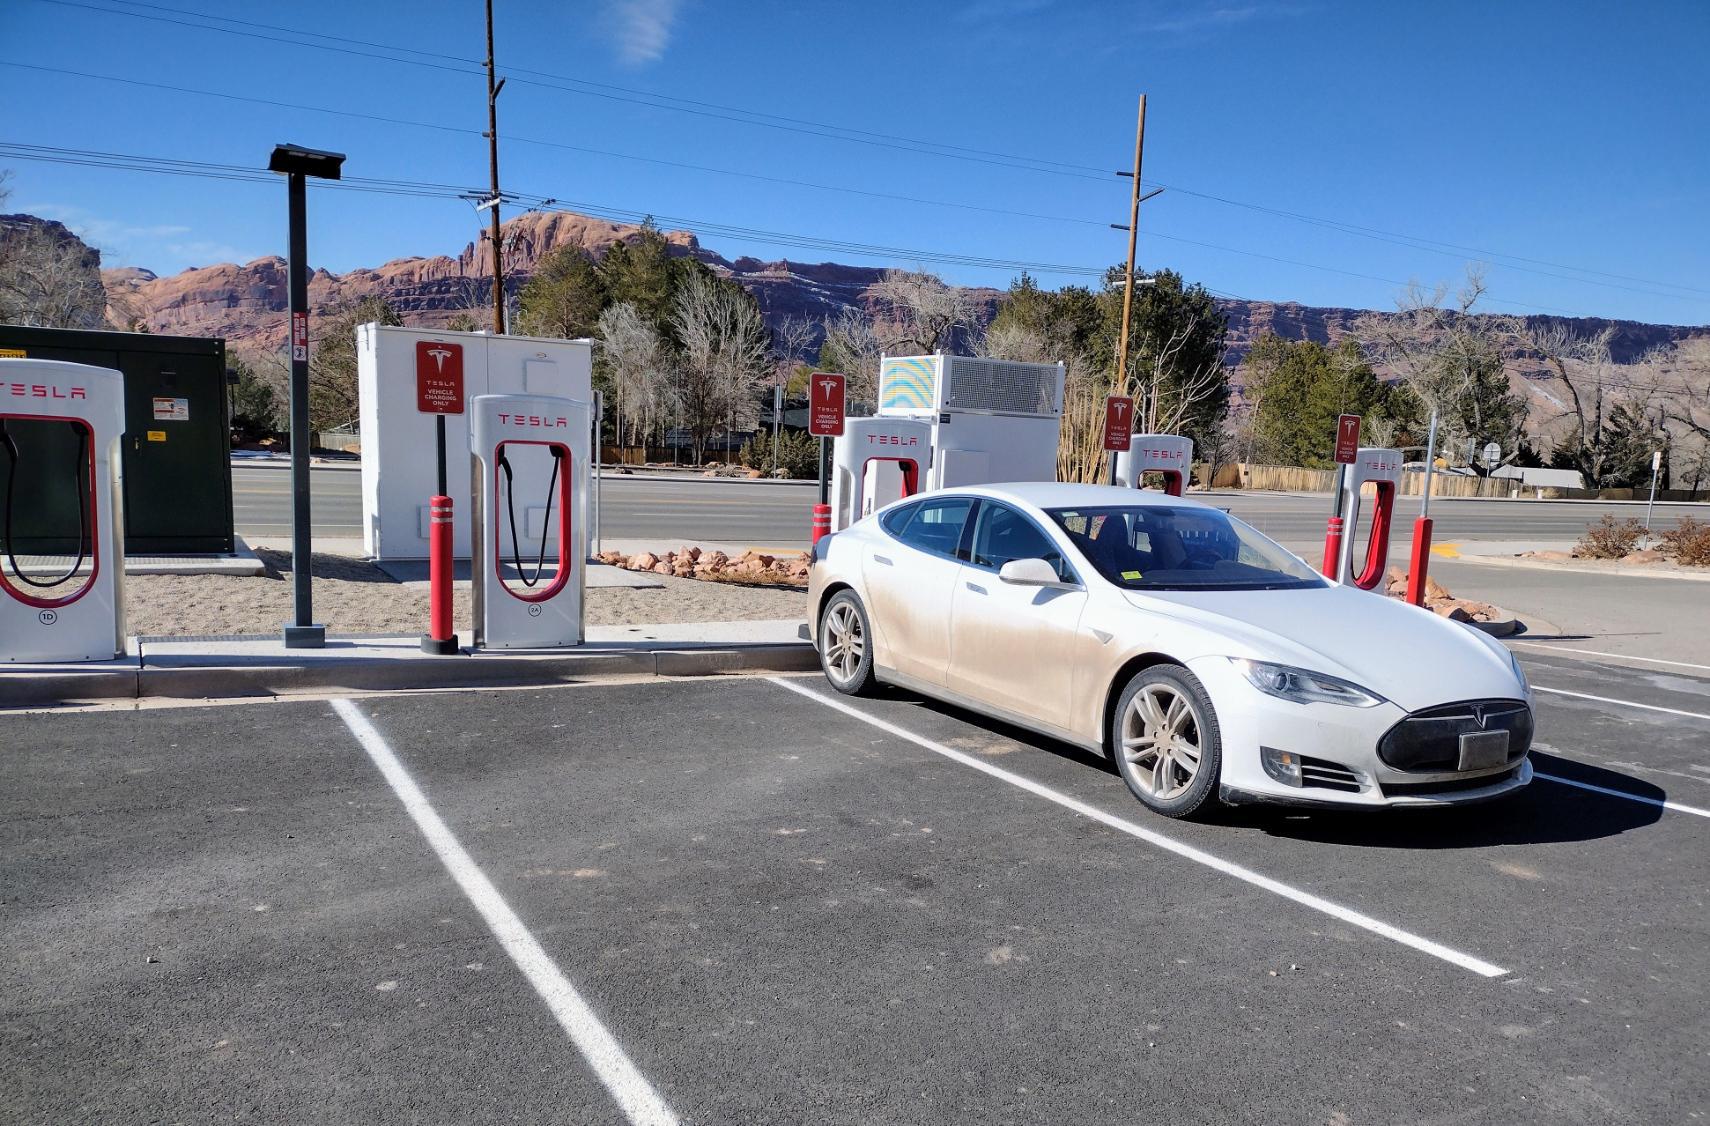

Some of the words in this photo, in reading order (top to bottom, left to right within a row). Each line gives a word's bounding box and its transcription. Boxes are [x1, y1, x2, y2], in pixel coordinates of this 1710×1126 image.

[498, 414, 566, 428] TESLA
[868, 434, 918, 446] TESLA
[1144, 450, 1182, 458] TESLA
[1366, 462, 1396, 470] TESLA
